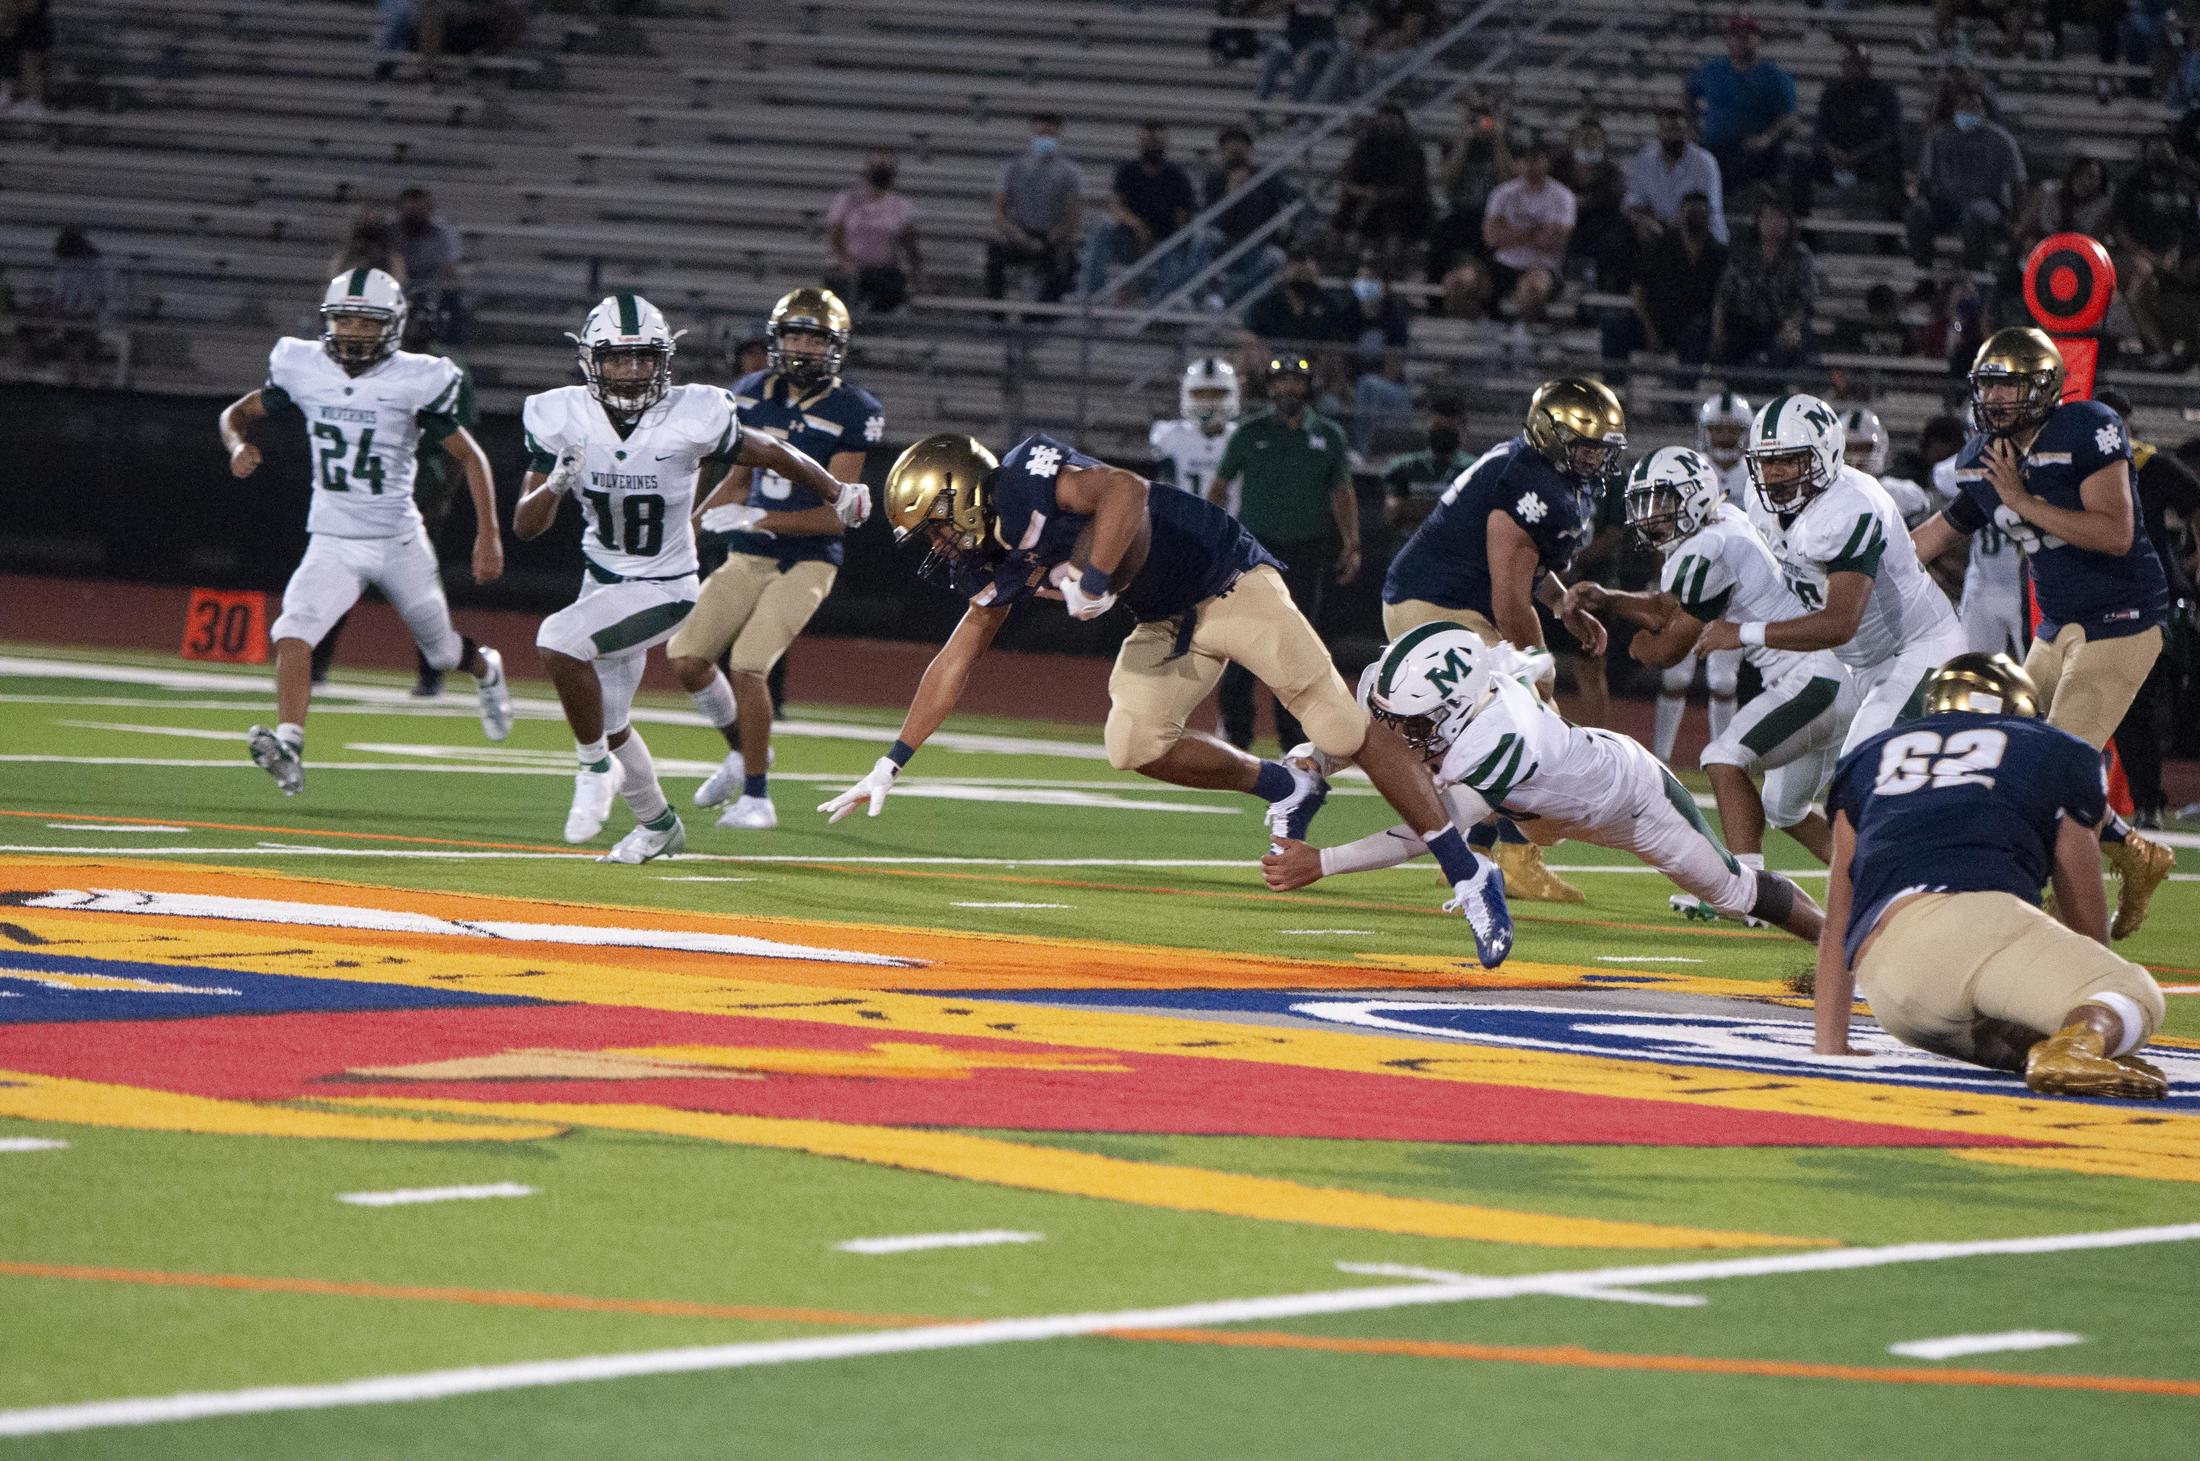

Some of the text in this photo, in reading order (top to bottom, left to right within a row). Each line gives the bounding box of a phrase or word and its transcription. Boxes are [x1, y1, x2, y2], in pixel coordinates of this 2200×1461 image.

[1803, 402, 1838, 438] M
[313, 421, 387, 496] 24
[591, 471, 659, 490] WOLVERINES
[582, 487, 666, 557] 18
[191, 600, 250, 654] 30
[1424, 647, 1473, 700] M
[1872, 728, 2008, 796] 62
